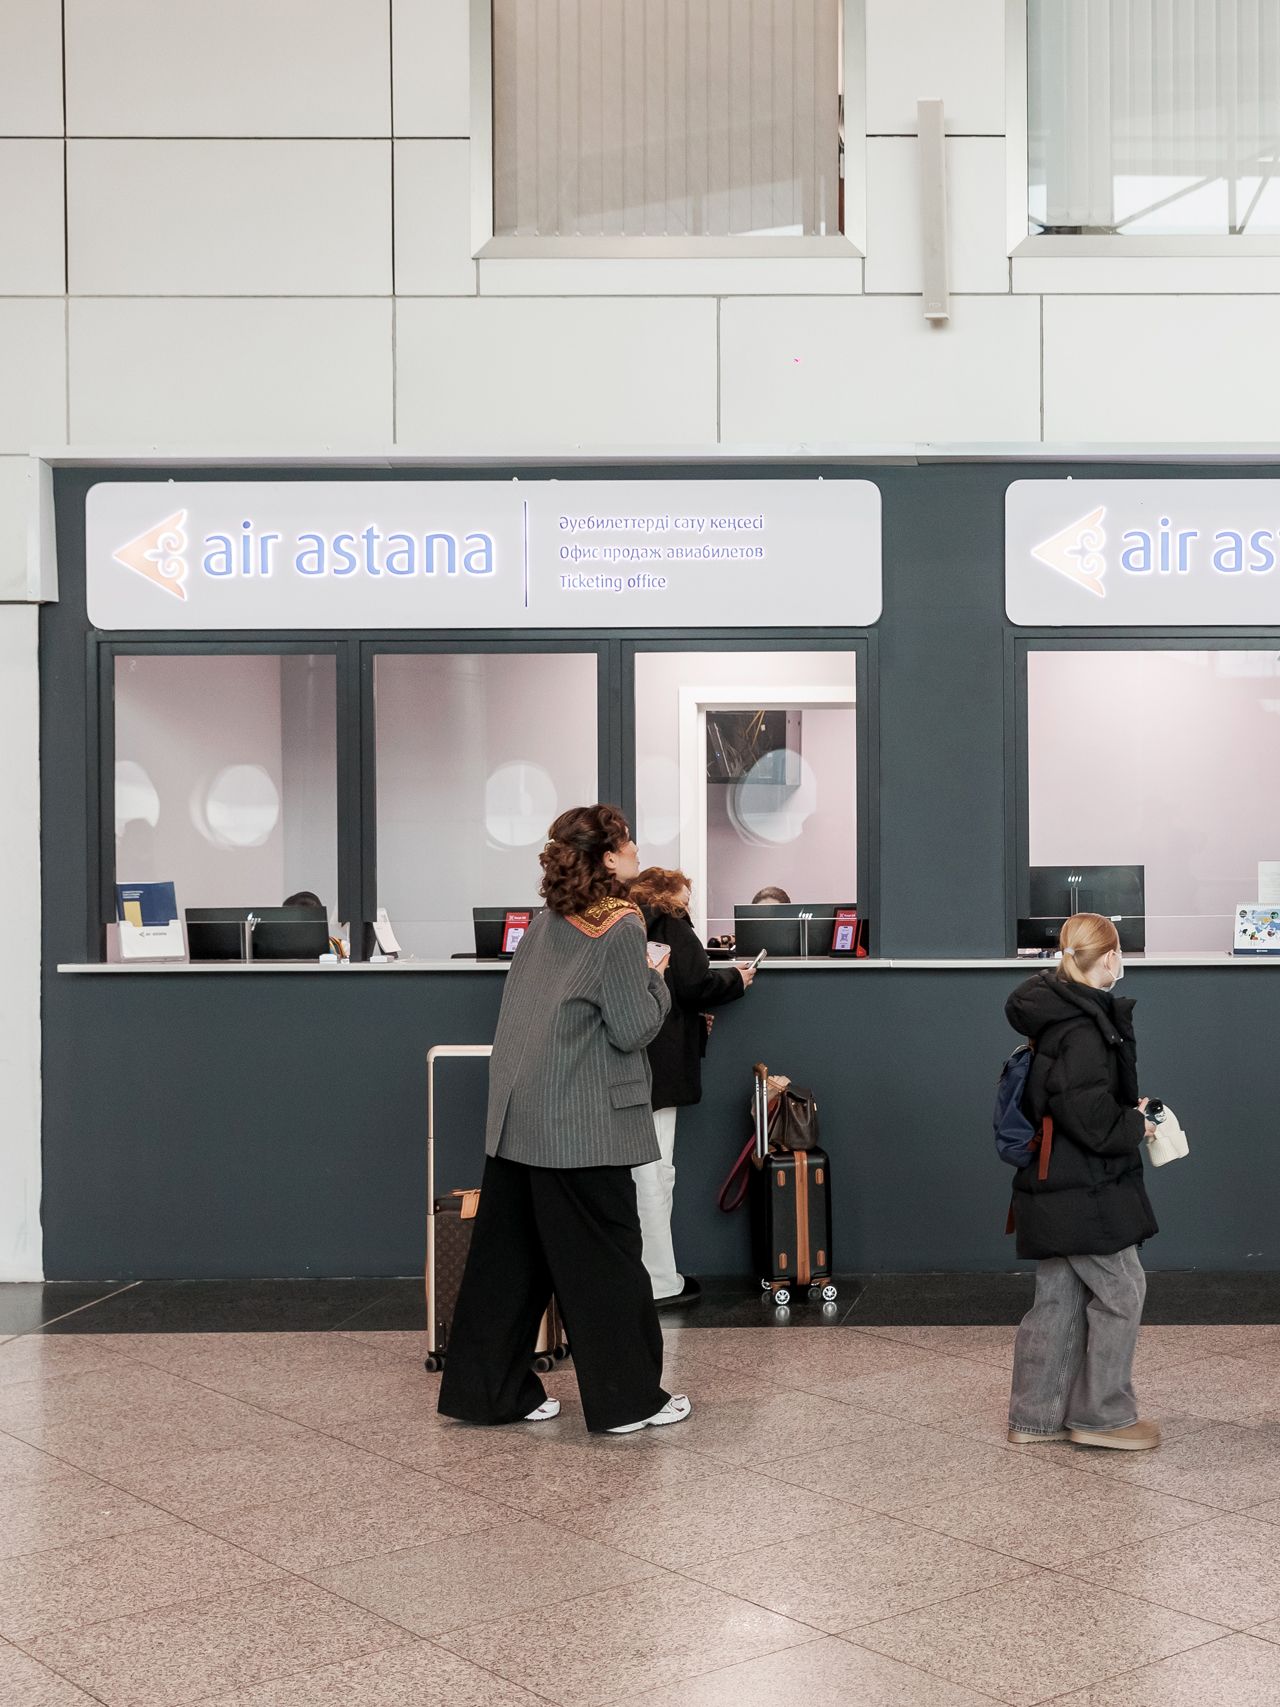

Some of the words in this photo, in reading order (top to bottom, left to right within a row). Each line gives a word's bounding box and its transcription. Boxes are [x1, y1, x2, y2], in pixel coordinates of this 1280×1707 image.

[559, 515, 670, 533] Әуебилеттерді
[674, 516, 706, 532] сату
[710, 515, 764, 531] кеңсесі
[203, 520, 275, 576] air
[295, 527, 494, 576] astana
[559, 545, 599, 562] Офис
[603, 547, 663, 561] продаж
[667, 545, 764, 559] авиабилетов
[1121, 517, 1199, 572] air
[559, 574, 623, 592] Ticketing
[627, 574, 667, 589] office
